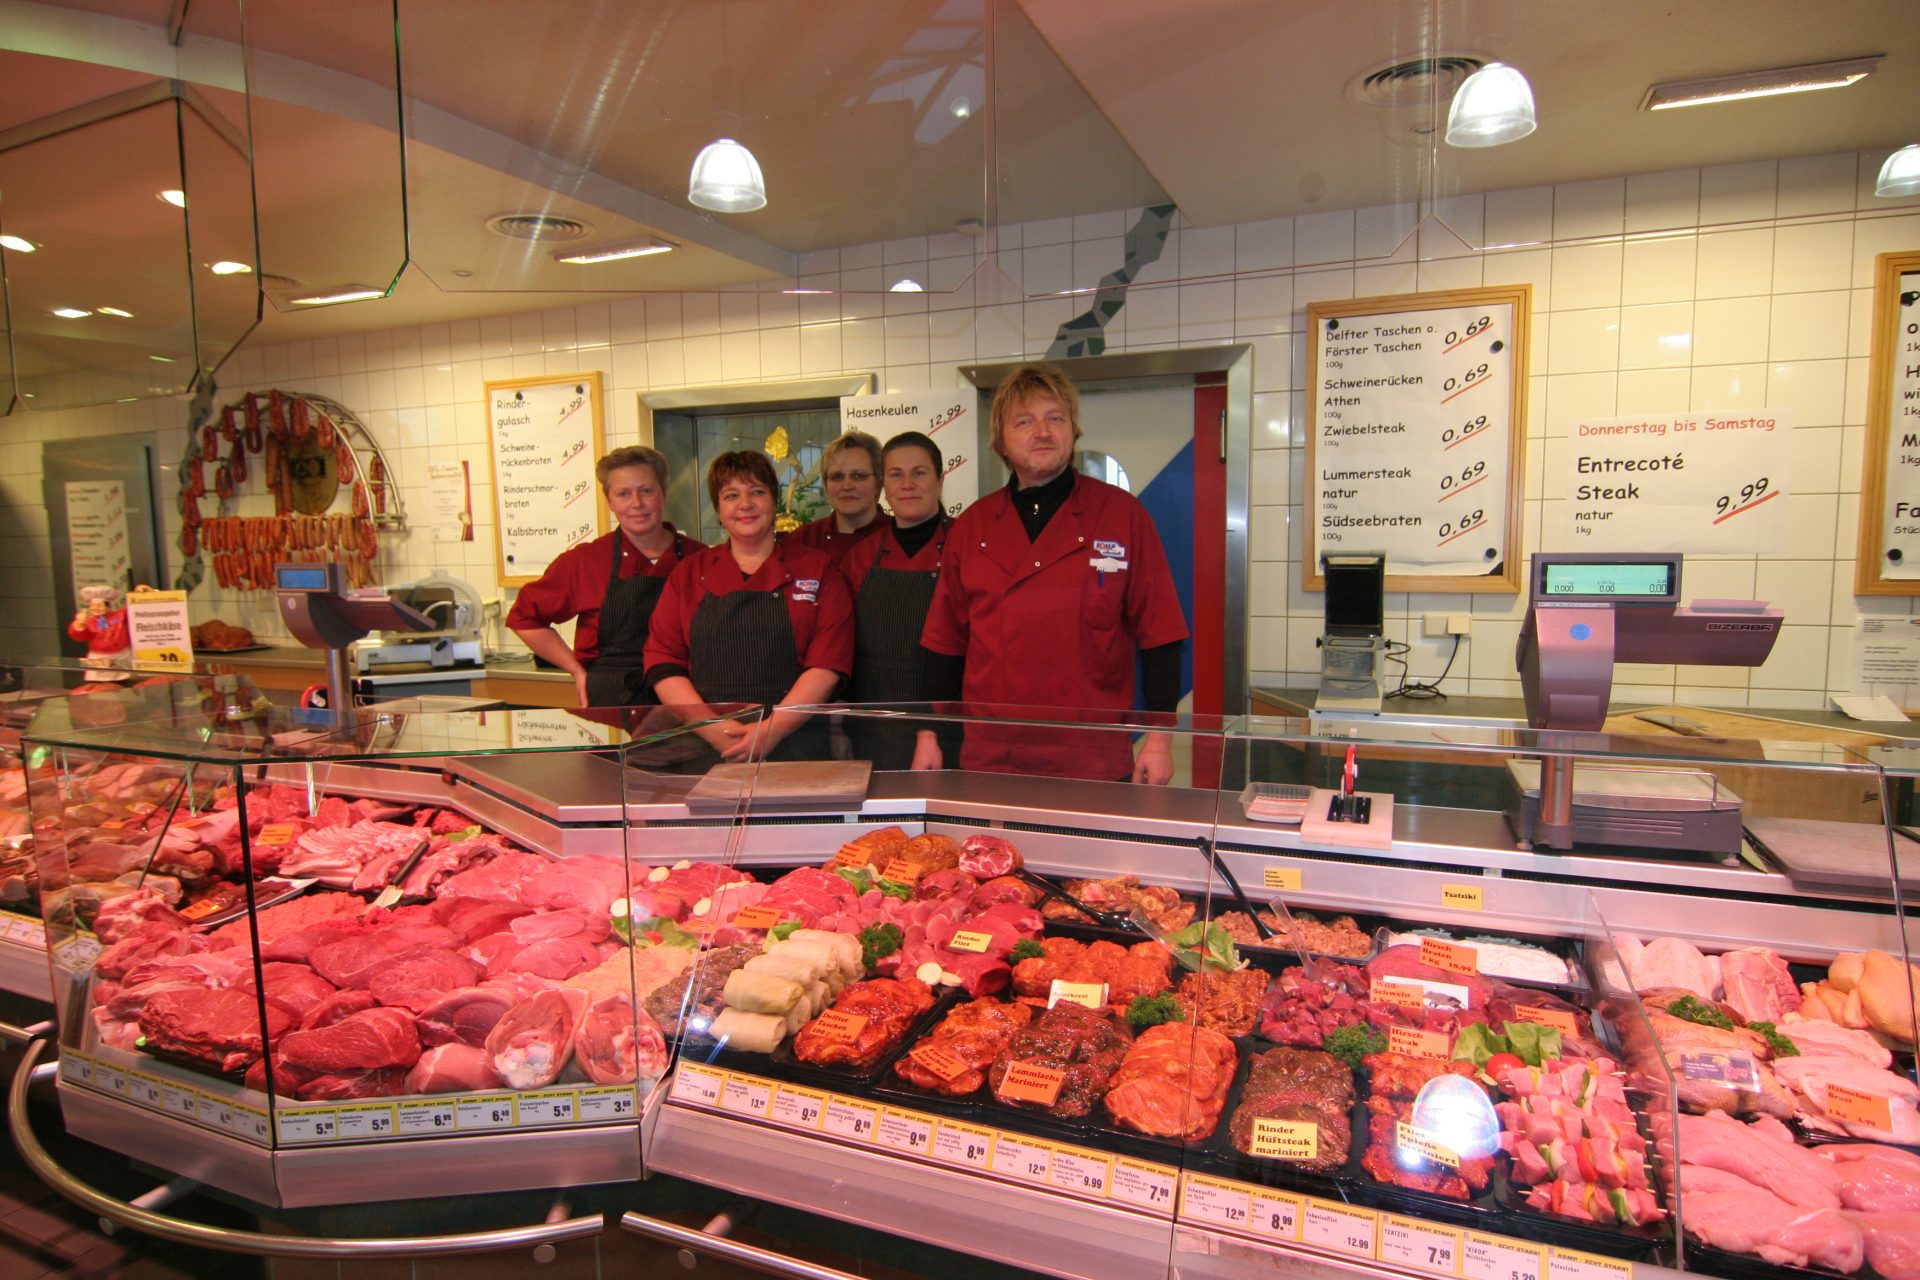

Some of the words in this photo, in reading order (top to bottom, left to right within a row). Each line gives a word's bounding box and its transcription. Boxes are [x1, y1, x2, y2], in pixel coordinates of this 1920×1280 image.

[1326, 329, 1368, 342] Delfter
[1374, 325, 1421, 336] Taschen
[1444, 316, 1490, 345] 0,69
[1325, 344, 1368, 357] Förster
[1374, 341, 1422, 353] Taschen
[1325, 361, 1343, 369] 100g
[1324, 374, 1423, 390] Schweinerücken
[1443, 363, 1488, 391] 0,69
[497, 400, 530, 410] Rinder-
[560, 397, 582, 416] 4,99
[1324, 396, 1360, 406] Athen
[846, 404, 918, 418] Hasenkeulen
[930, 404, 960, 428] 12,99
[1324, 411, 1341, 420] 100g
[497, 416, 530, 429] gulasch
[1324, 422, 1406, 436] Zwiebelsteak
[1441, 415, 1487, 442] 0,69
[1578, 421, 1667, 437] Donnerstag
[1674, 418, 1697, 432] bis
[1704, 416, 1776, 432] Samstag
[500, 444, 540, 453] Schweine-
[562, 440, 584, 460] 4,99
[501, 456, 552, 468] rückenbraten
[1578, 452, 1684, 474] Entrecoté
[1323, 467, 1412, 480] Lummersteak
[1440, 461, 1485, 490] 0,69
[504, 484, 559, 494] Rinderschmor-
[564, 481, 587, 500] 5,99
[1322, 488, 1358, 499] natur
[1576, 484, 1640, 500] Steak
[1716, 477, 1769, 515] 9,99
[505, 500, 530, 508] braten
[1322, 515, 1422, 528] Südseebraten
[1576, 509, 1613, 521] natur
[1438, 509, 1483, 538] 0,69
[507, 526, 558, 536] Kalbsbraten
[1322, 532, 1342, 541] 100g
[1576, 525, 1592, 536] 1kg
[1444, 892, 1476, 900] Tzatziki
[957, 934, 980, 942] Rinder
[1423, 940, 1452, 952] Hirsch
[1422, 948, 1452, 960] Braten
[1373, 988, 1410, 998] Schwein
[822, 1012, 848, 1022] Delfter
[817, 1020, 847, 1031] Taschen
[1392, 1028, 1424, 1039] Hirsch
[1392, 1037, 1419, 1046] Steak
[1010, 1066, 1060, 1082] Lammlachs
[1008, 1076, 1049, 1090] Mariniert
[1258, 1124, 1295, 1134] Rinder
[1257, 1134, 1311, 1146] Hüftsteak
[1400, 1134, 1437, 1150] Spieße
[967, 1145, 984, 1160] 8.99
[1256, 1147, 1309, 1156] mariniert
[1400, 1142, 1456, 1164] mariniert
[1084, 1176, 1102, 1189] 9.99
[1150, 1185, 1169, 1201] 7.99
[1272, 1214, 1292, 1230] 8.99
[1384, 1228, 1408, 1238] TZATZIKI
[1348, 1236, 1368, 1250] 12.99
[1428, 1246, 1450, 1265] 7.99
